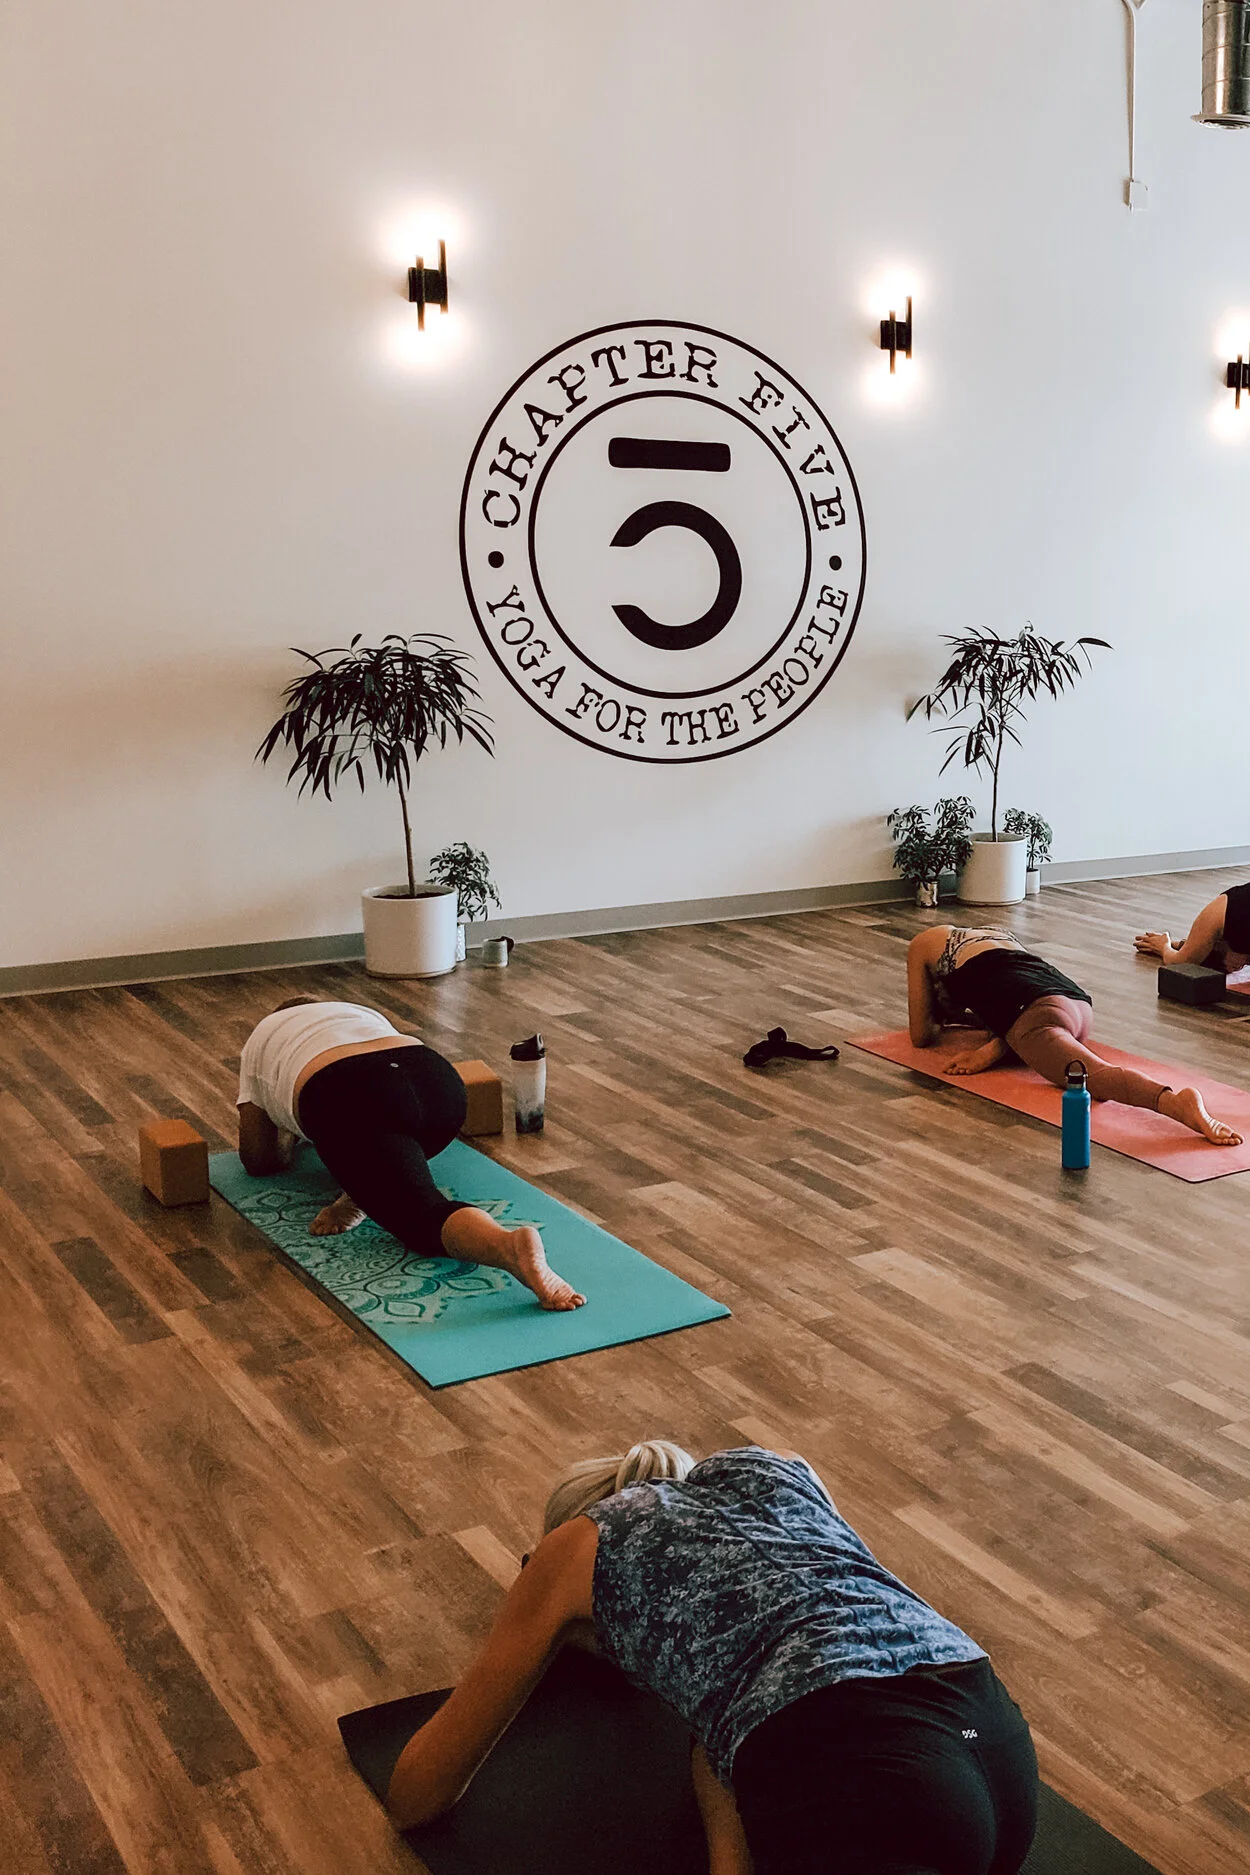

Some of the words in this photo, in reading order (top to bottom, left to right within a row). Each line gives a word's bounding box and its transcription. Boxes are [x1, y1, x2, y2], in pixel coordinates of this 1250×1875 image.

[482, 340, 719, 529] CHAPTER
[739, 371, 846, 531] FIVE
[486, 585, 567, 699] YOGA
[565, 683, 647, 744] FOR
[661, 703, 740, 746] THE
[741, 584, 849, 725] PEOPLE
[962, 1729, 978, 1739] DSG
